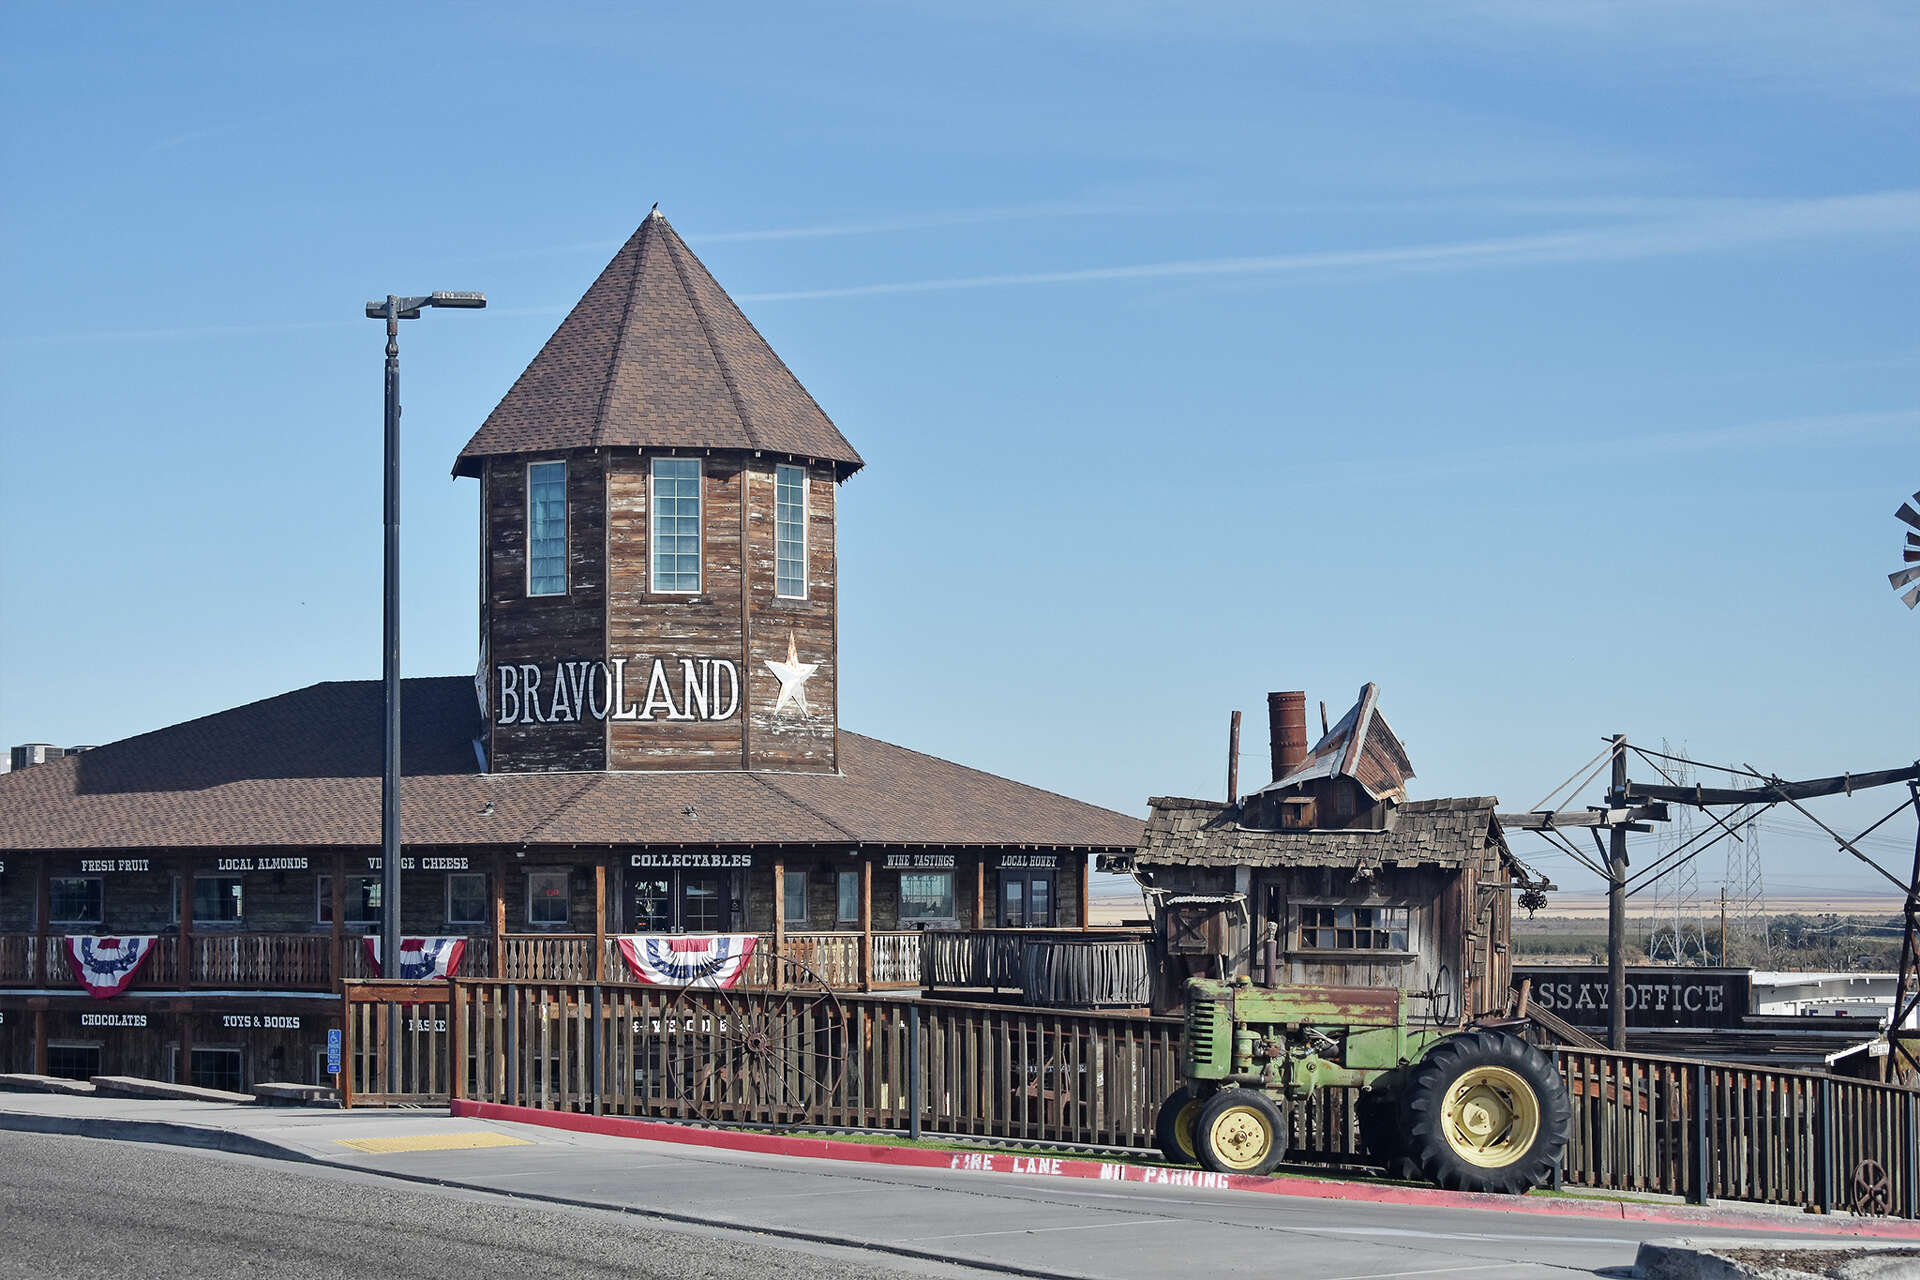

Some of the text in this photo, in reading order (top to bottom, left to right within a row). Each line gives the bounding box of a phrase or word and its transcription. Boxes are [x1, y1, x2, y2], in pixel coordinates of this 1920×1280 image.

[498, 658, 739, 724] BRAVOLAND
[81, 859, 149, 871] FRESH FRUIT
[218, 857, 308, 870] LOCAL ALMONDS
[367, 857, 469, 869] VIGE CHEESE
[631, 854, 752, 867] COLLECTABLES
[887, 855, 955, 867] WINE TASTINGS
[1001, 855, 1057, 867] LOCAL HONEY
[1625, 984, 1723, 1012] OFFICE
[81, 1014, 147, 1027] CHOCOLATES
[223, 1015, 300, 1029] TOYS & BOOKS
[951, 1153, 1062, 1174] FIRE LANE
[1144, 1166, 1229, 1189] PARKING
